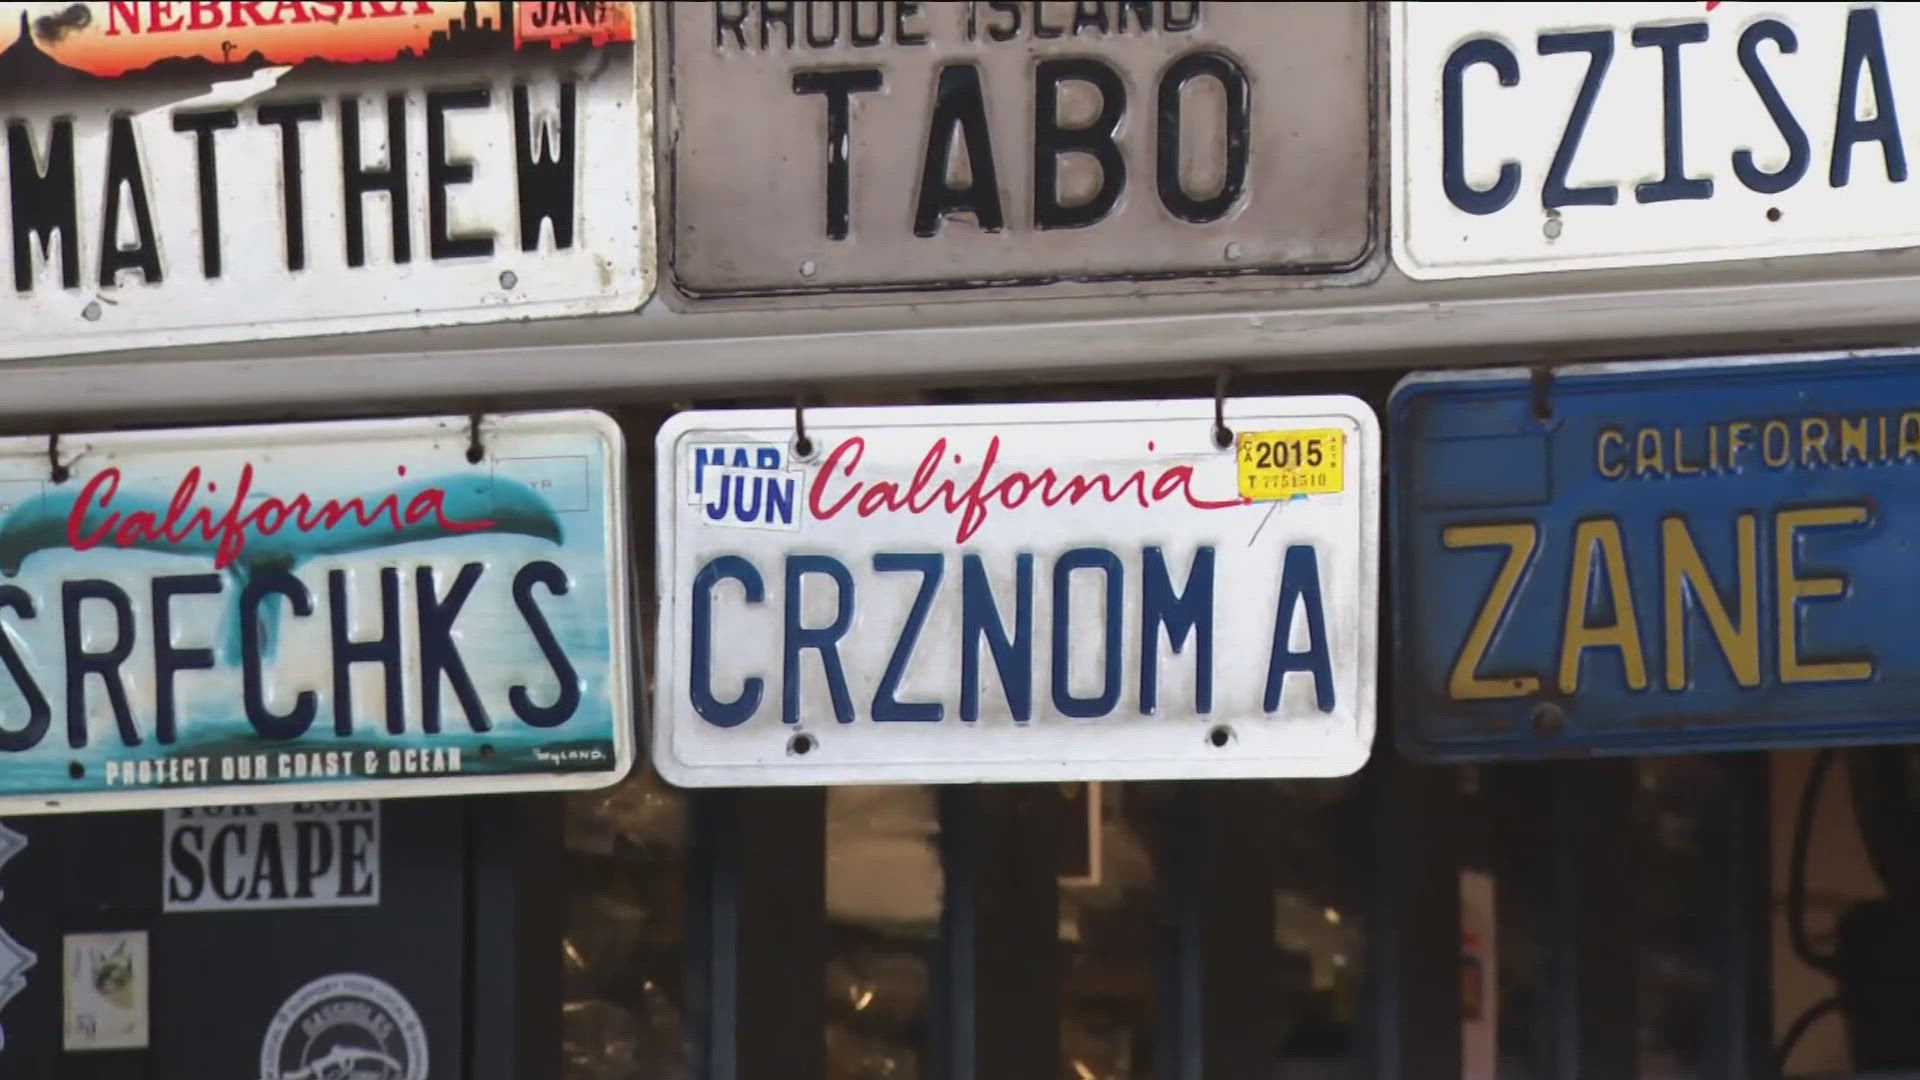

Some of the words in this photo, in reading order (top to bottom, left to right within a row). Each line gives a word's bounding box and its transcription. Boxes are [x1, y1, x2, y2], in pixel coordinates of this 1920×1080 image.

[714, 0, 929, 50] RHODE
[966, 0, 1200, 42] ISLAND
[792, 50, 1252, 242] TABO
[1442, 8, 1908, 216] CZISA
[6, 80, 578, 292] MATTHEW
[808, 434, 1252, 544] California
[1256, 439, 1323, 469] 2015
[1598, 411, 1920, 478] CALIFORNIA
[67, 462, 496, 570] California
[705, 474, 795, 525] JUN
[0, 560, 582, 752] SRFCHKS
[690, 544, 1217, 728] CRZNOM
[1263, 544, 1336, 714] A
[1443, 505, 1873, 700] ZANE
[105, 756, 211, 786] PROTECT
[220, 754, 268, 781] OUR
[277, 750, 351, 778] COAST
[363, 750, 380, 775] &
[388, 746, 462, 774] OCEAN
[169, 818, 374, 904] SCAPE
